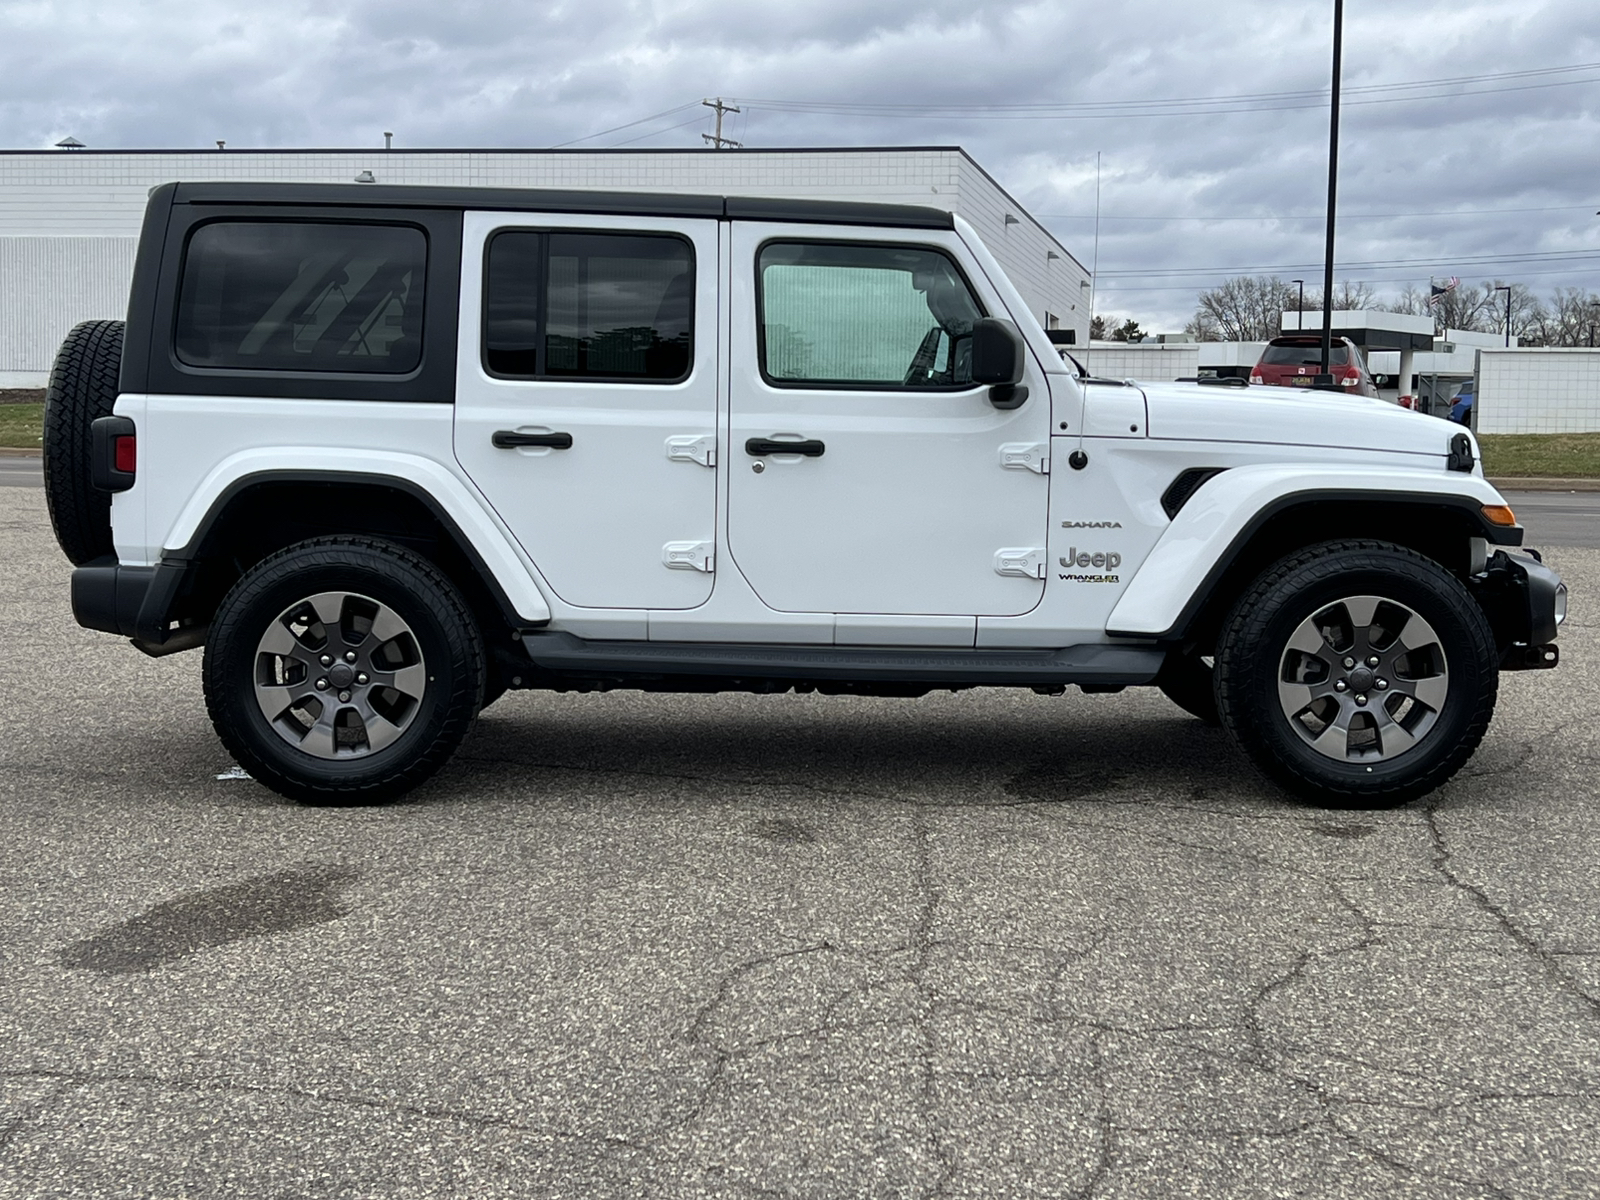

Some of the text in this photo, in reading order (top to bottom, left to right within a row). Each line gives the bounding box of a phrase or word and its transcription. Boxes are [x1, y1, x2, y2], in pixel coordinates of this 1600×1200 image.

[1061, 521, 1122, 529] SAHARA
[1059, 546, 1121, 572] Jeep
[1058, 573, 1119, 581] WRANGLER
